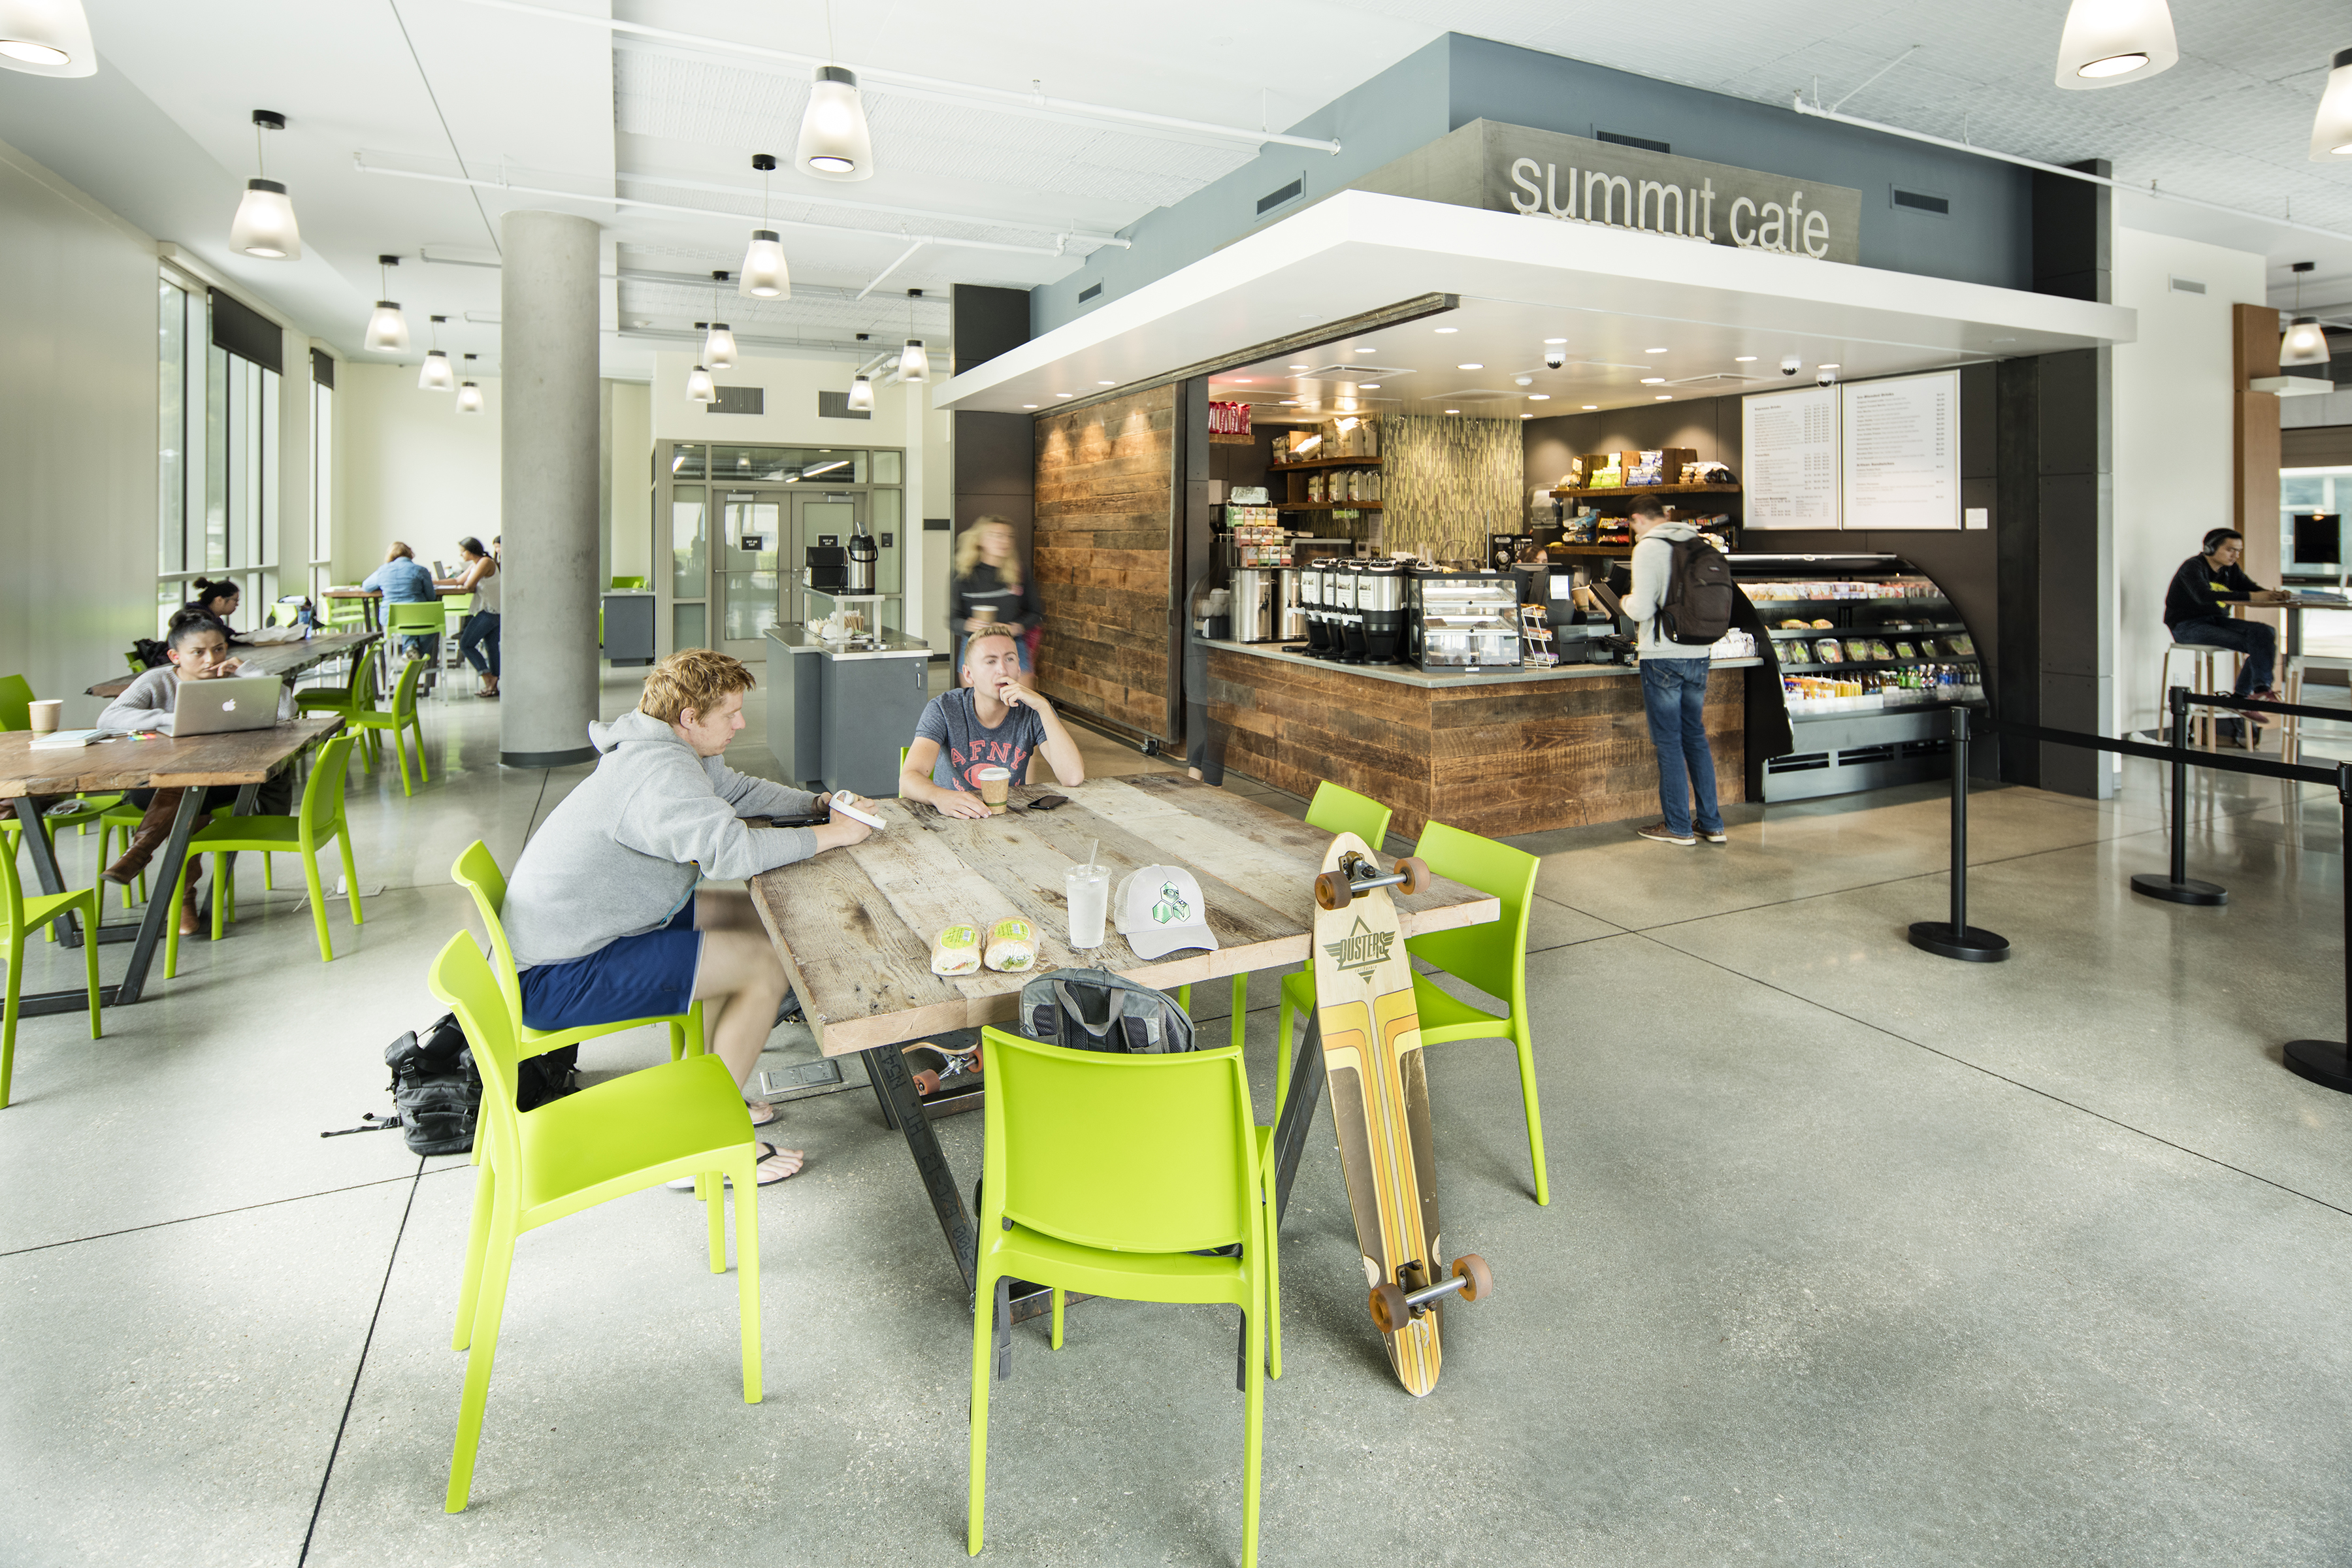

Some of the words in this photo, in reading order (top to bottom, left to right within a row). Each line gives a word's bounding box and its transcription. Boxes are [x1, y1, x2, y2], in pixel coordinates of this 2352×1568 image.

[1510, 157, 1715, 240] summit
[1729, 190, 1830, 259] cafe
[951, 740, 1027, 770] AFNY
[1340, 931, 1386, 962] DUSTERS
[1354, 964, 1377, 973] california
